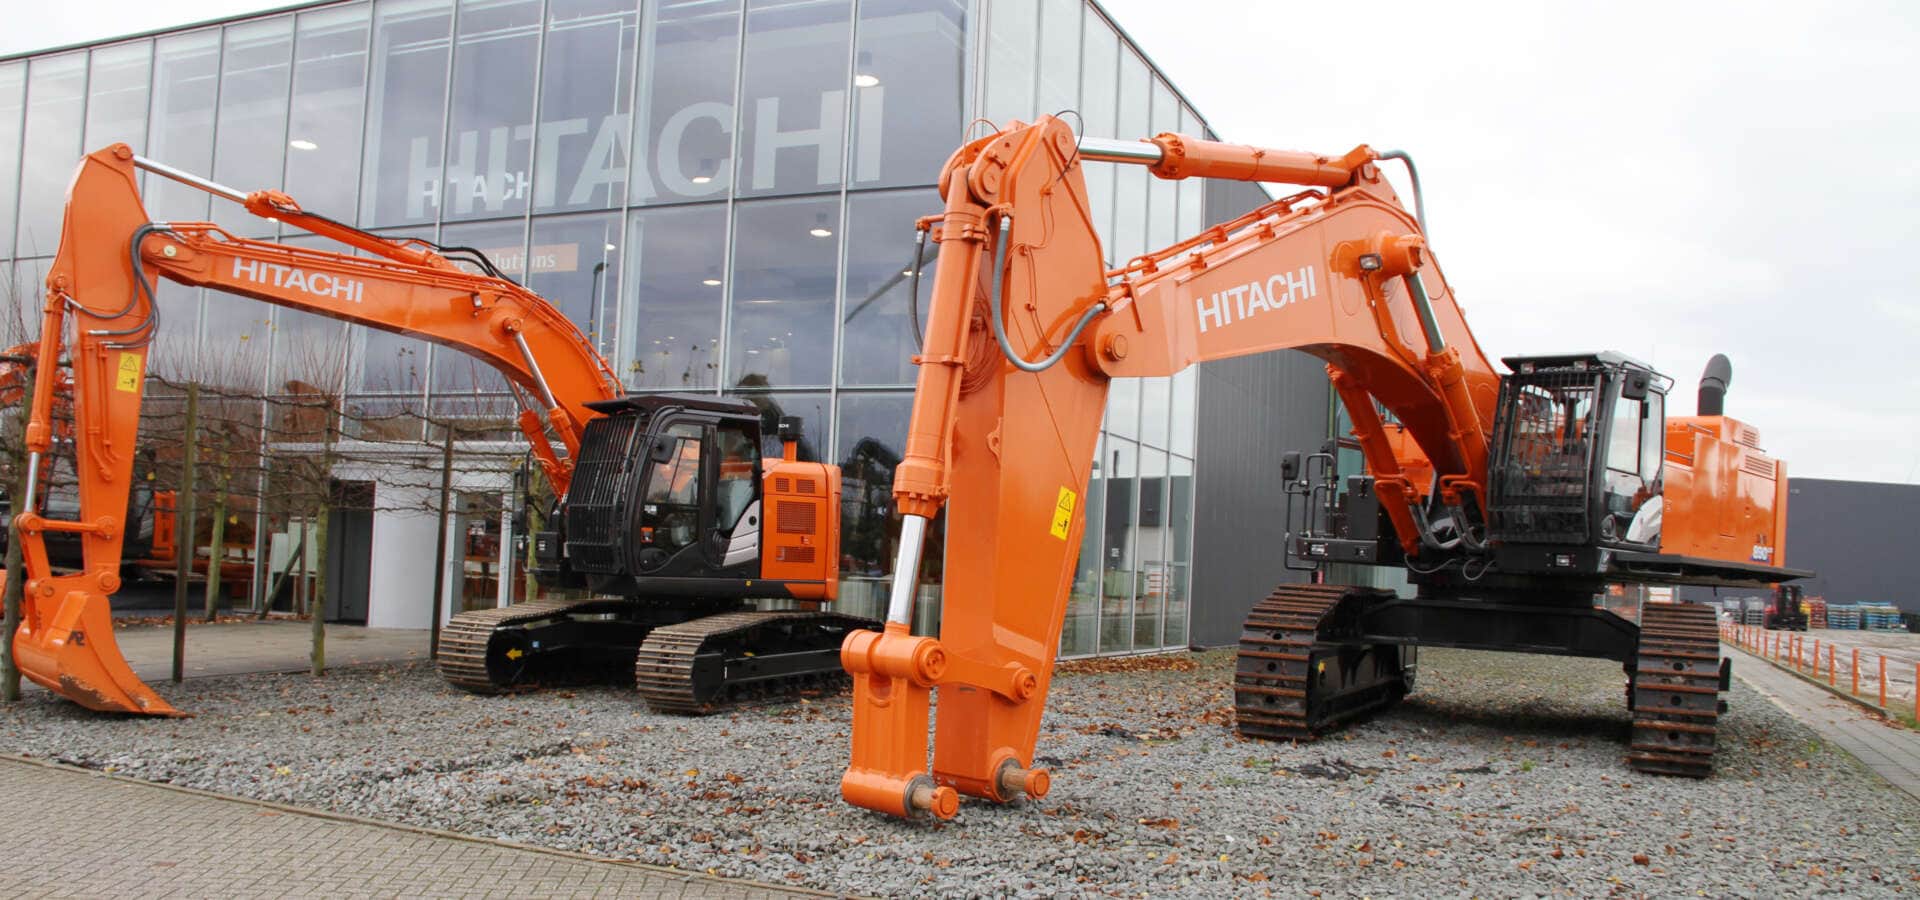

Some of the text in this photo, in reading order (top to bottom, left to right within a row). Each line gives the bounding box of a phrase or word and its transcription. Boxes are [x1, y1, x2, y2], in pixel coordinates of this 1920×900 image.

[406, 86, 884, 219] HITACHI
[232, 256, 363, 303] HITACHI
[1196, 265, 1316, 333] HITACHI
